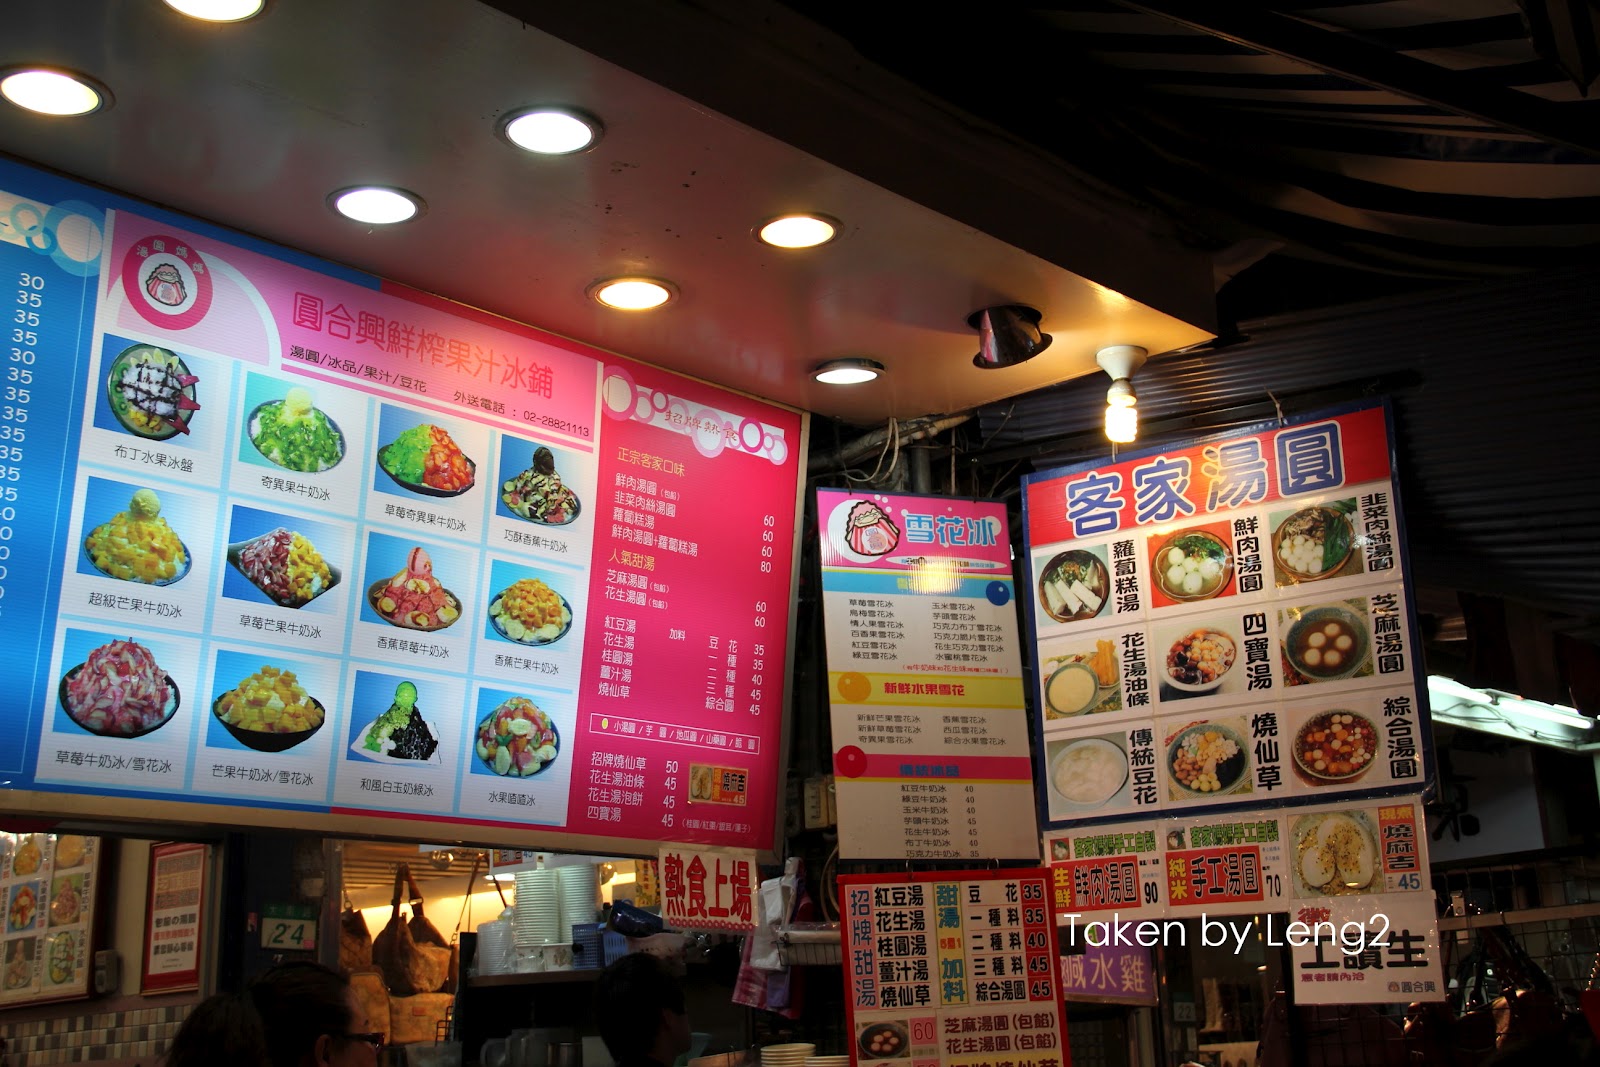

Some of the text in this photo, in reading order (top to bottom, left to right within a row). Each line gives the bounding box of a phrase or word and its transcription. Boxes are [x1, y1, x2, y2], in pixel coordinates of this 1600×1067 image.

[19, 273, 44, 290] 30
[17, 291, 42, 307] 35
[15, 310, 39, 326] 35
[12, 329, 37, 345] 35
[10, 348, 35, 365] 30
[8, 368, 32, 384] 35
[5, 387, 30, 403] 35
[3, 406, 28, 423] 35
[524, 411, 589, 437] 02-28821113
[0, 426, 25, 442] 35
[115, 445, 193, 473] 布丁水果冰盤
[618, 447, 685, 477] 正宗客家口味
[262, 476, 330, 501] 奇異果牛奶冰
[1066, 420, 1346, 538] 客家湯圓
[615, 473, 774, 527] 鮮肉湯圓 60
[385, 504, 467, 532] 草莓奇異果牛奶冰
[613, 507, 772, 557] 蘿蔔糕湯 60
[763, 531, 773, 542] 60
[905, 514, 997, 546] 雪花冰
[1361, 493, 1394, 573] 韭菜肉絲湯圓
[609, 549, 655, 572] 人氣甜湯
[1233, 516, 1264, 594] 鮮肉湯圓
[761, 561, 771, 573] 80
[1112, 539, 1140, 614] 蘿蔔糕湯
[606, 569, 766, 613] 芝麻湯圓 60
[89, 592, 182, 618] 超級芒果牛奶冰
[605, 586, 765, 628] 花生湯圓 60
[932, 603, 976, 611] 玉米雪花冰
[240, 615, 322, 639] 草莓芒果牛奶冰
[605, 616, 636, 634] 紅豆湯
[669, 628, 686, 641] 加料
[850, 620, 904, 629] 情人果雪花冰
[851, 630, 905, 639] 百香果雪花冰
[933, 623, 1002, 632] 巧克力布丁雪花冰
[1372, 593, 1404, 674] 芝麻湯圓
[377, 636, 449, 659] 香蕉草莓牛奶冰
[604, 632, 635, 650] 花生湯
[754, 644, 764, 655] 35
[852, 642, 897, 650] 紅豆雪花冰
[935, 643, 1005, 653] 花生巧克力雪花冰
[602, 650, 633, 666] 桂圓湯
[1243, 612, 1273, 692] 四寶湯
[495, 655, 559, 675] 香蕉芒果牛奶冰
[600, 665, 632, 682] 薑汁湯
[753, 659, 763, 670] 35
[1122, 632, 1150, 708] 花生湯油條
[598, 683, 630, 698] 燒仙草
[752, 674, 762, 686] 40
[884, 682, 965, 696] 新鮮水果雪花
[751, 689, 761, 700] 45
[750, 704, 760, 716] 45
[1383, 696, 1418, 779] 綜合湯圓
[56, 751, 172, 774] 草莓牛奶冰/雪花冰
[591, 751, 678, 773] 招牌燒仙草 50
[1252, 713, 1283, 791] 燒仙草
[212, 765, 314, 786] 芒果牛奶冰/雪花冰
[1129, 729, 1158, 805] 傳統豆花
[590, 769, 676, 790] 花生湯油條 45
[588, 787, 675, 809] 花生湯泡餅 45
[588, 806, 674, 827] 四寶湯 45
[1379, 806, 1414, 820] 現煮
[1383, 824, 1416, 870] 燒麻吉
[1074, 862, 1158, 907] 鮮肉湯圓 90
[1169, 858, 1188, 899] 純米
[1191, 853, 1281, 898] 手工湯圓 70
[1398, 874, 1420, 890] 45
[665, 853, 752, 922] 熱食上場
[875, 885, 924, 907] 紅豆湯
[1024, 885, 1042, 899] 35
[1054, 868, 1071, 908] 生鮮
[876, 910, 925, 932] 花生湯
[1026, 909, 1044, 923] 35
[272, 924, 305, 944] 24
[1028, 933, 1046, 947] 40
[851, 890, 876, 1007] 招牌甜湯
[878, 935, 927, 957] 桂圓湯
[879, 960, 929, 983] 薑汁湯
[1030, 958, 1048, 971] 45
[881, 985, 931, 1008] 燒仙草
[976, 980, 1050, 1002] 綜合湯圓 45
[1402, 981, 1436, 993] 圓合興
[914, 1022, 934, 1040] 60
